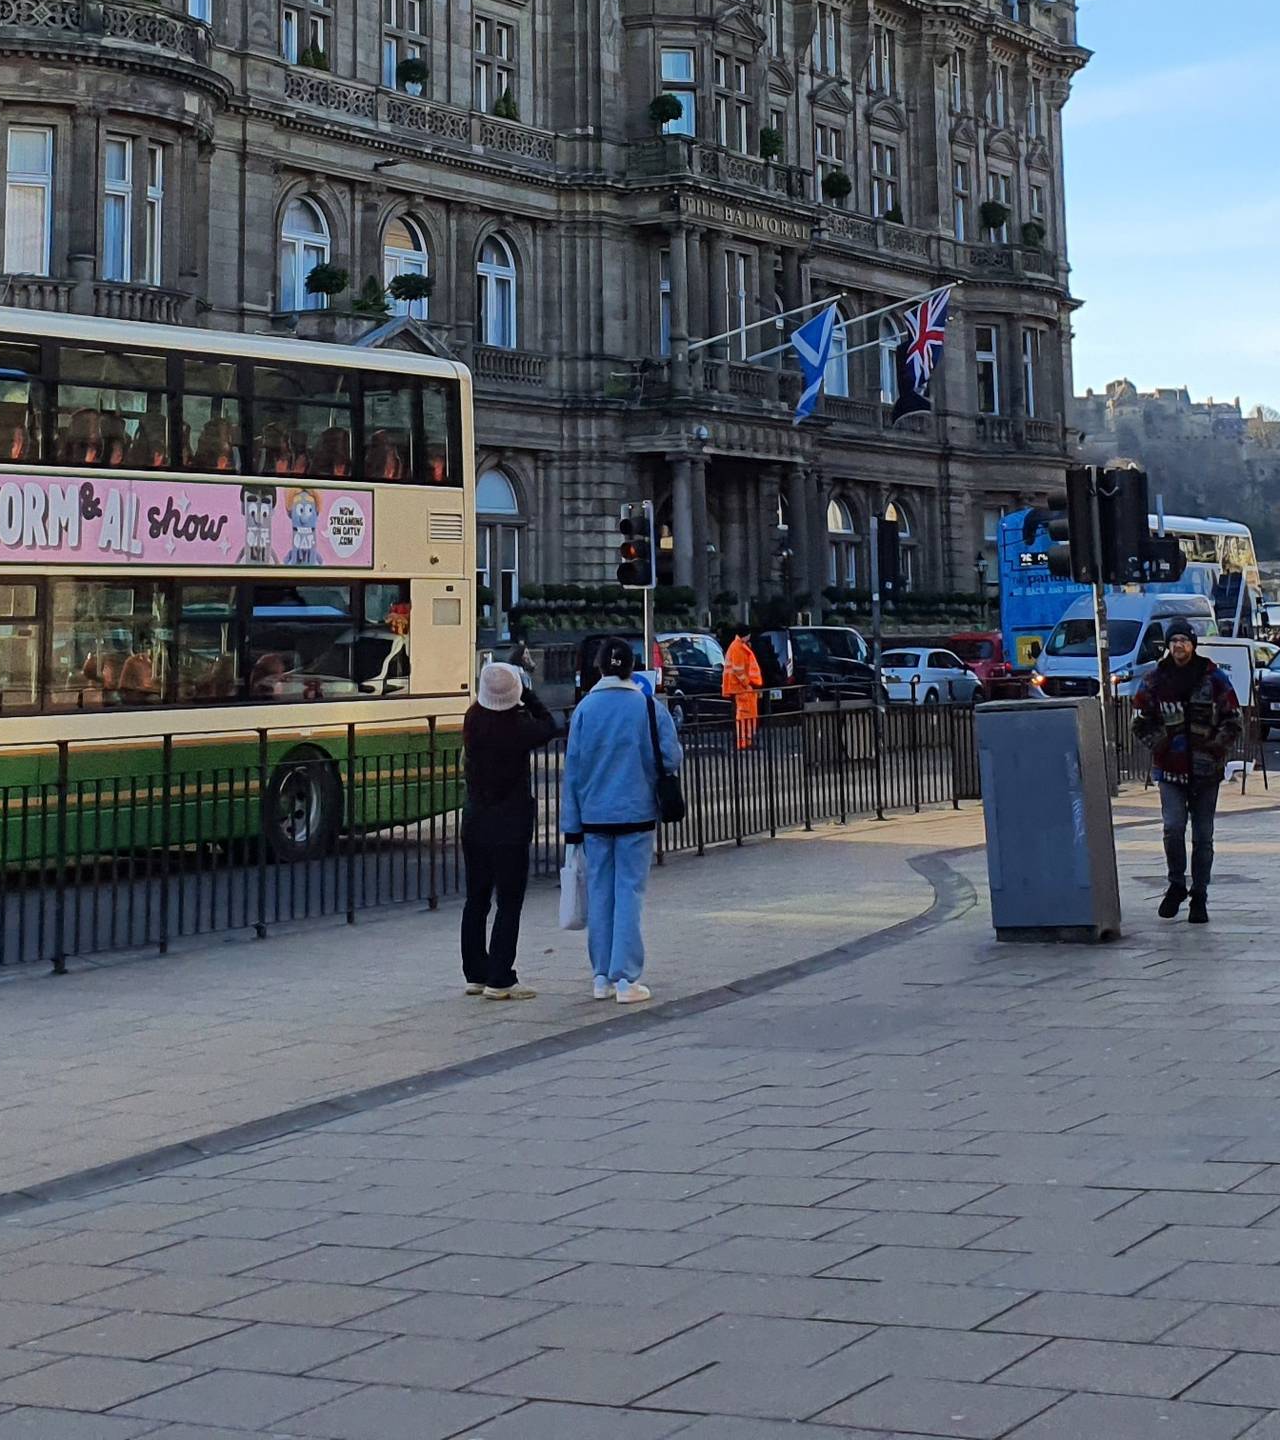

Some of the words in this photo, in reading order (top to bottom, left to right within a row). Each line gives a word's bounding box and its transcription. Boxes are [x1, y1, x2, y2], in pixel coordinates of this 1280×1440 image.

[724, 205, 811, 241] BALMORAL
[79, 481, 103, 521] &
[98, 487, 144, 558] AL
[147, 496, 228, 542] show
[329, 516, 364, 527] STREAMING
[339, 506, 355, 516] NOW
